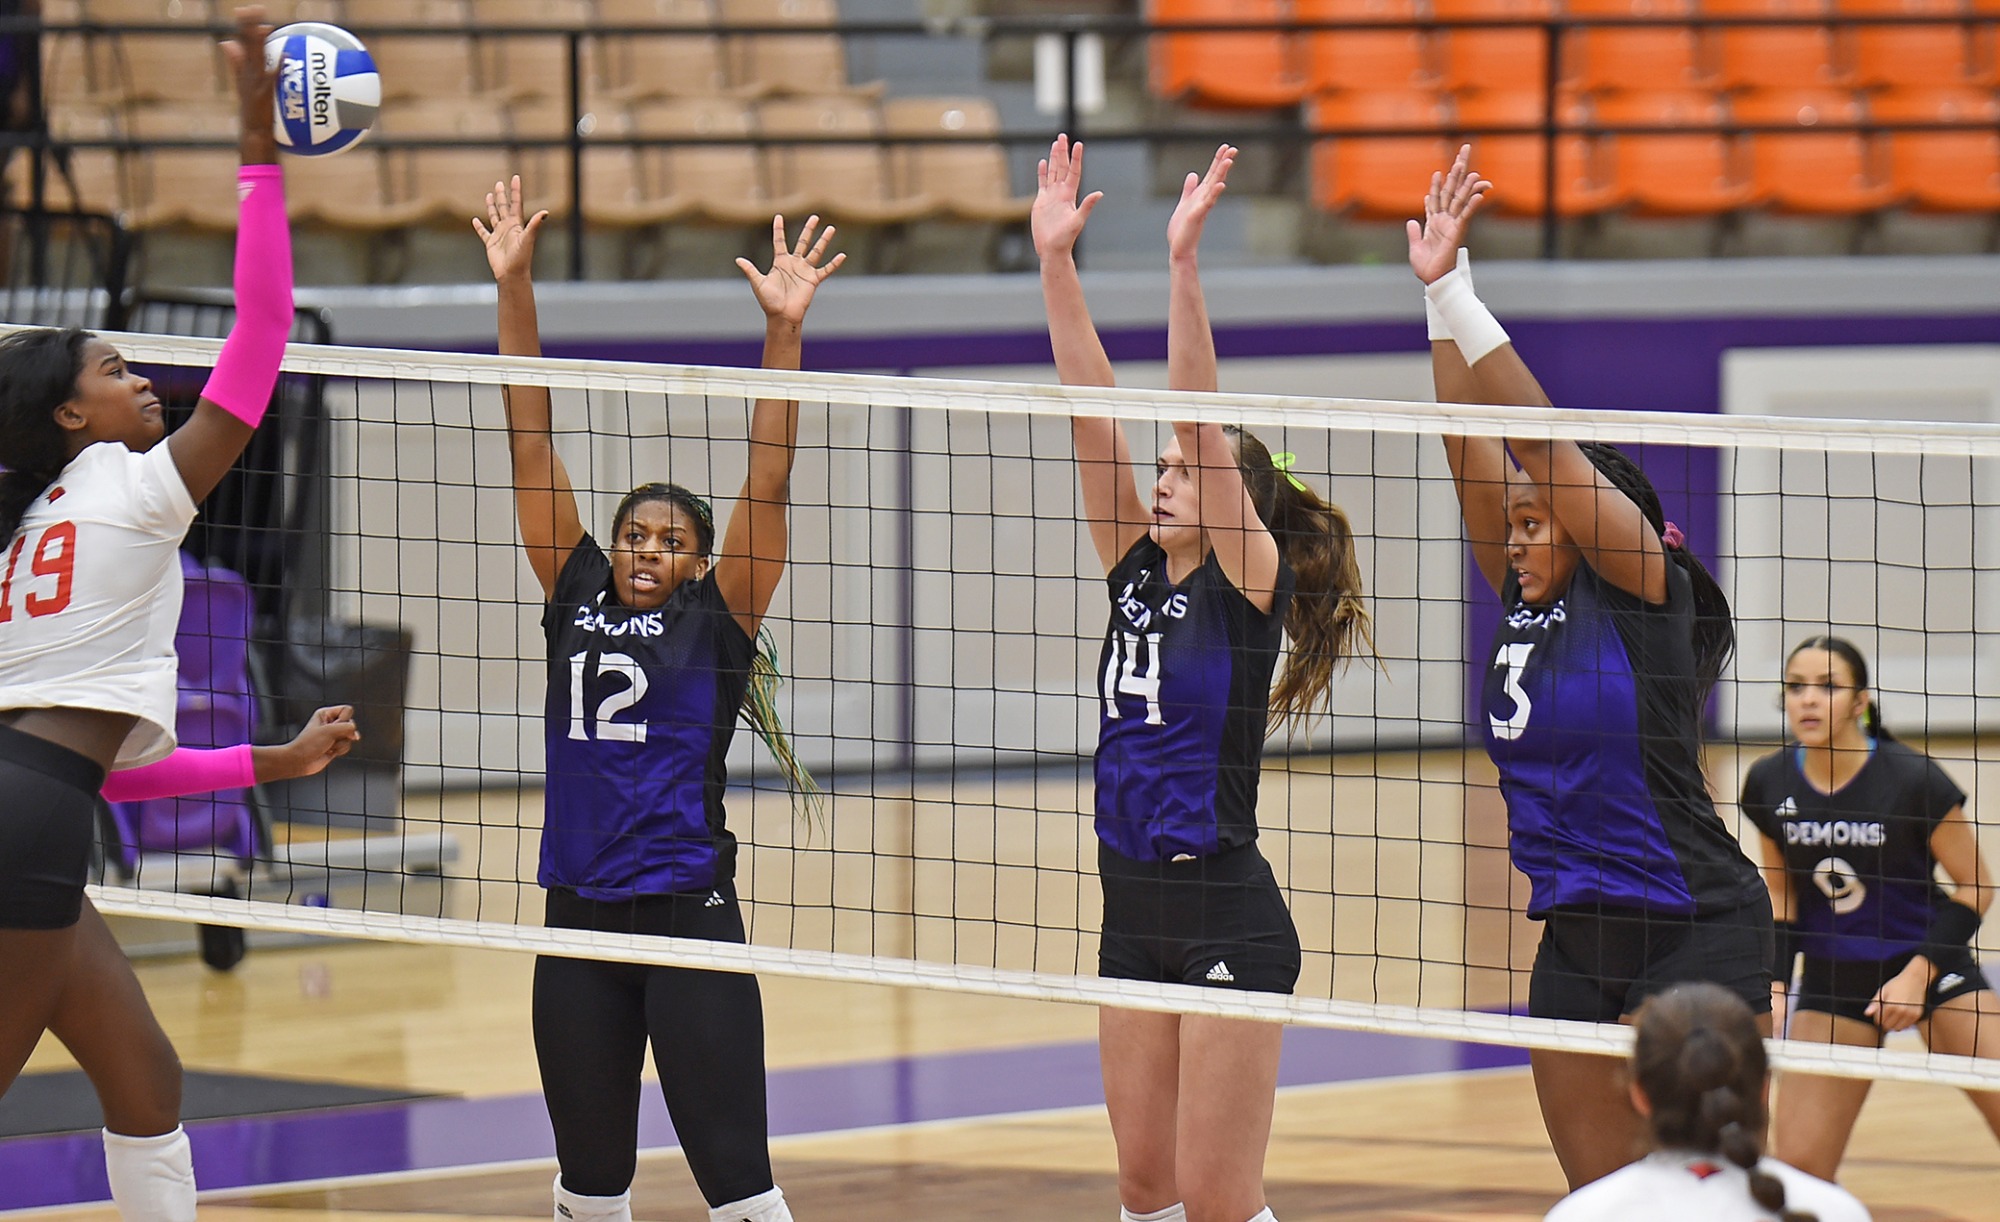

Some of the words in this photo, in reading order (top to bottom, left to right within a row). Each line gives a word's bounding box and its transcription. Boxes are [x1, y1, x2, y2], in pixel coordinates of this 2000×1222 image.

[283, 58, 306, 119] NCAA
[311, 52, 331, 125] molten
[0, 520, 76, 624] 19
[567, 650, 649, 743] 12
[1105, 629, 1167, 725] 14
[1489, 643, 1535, 740] 3
[1783, 820, 1886, 848] DEMONS
[1812, 856, 1867, 915] 9
